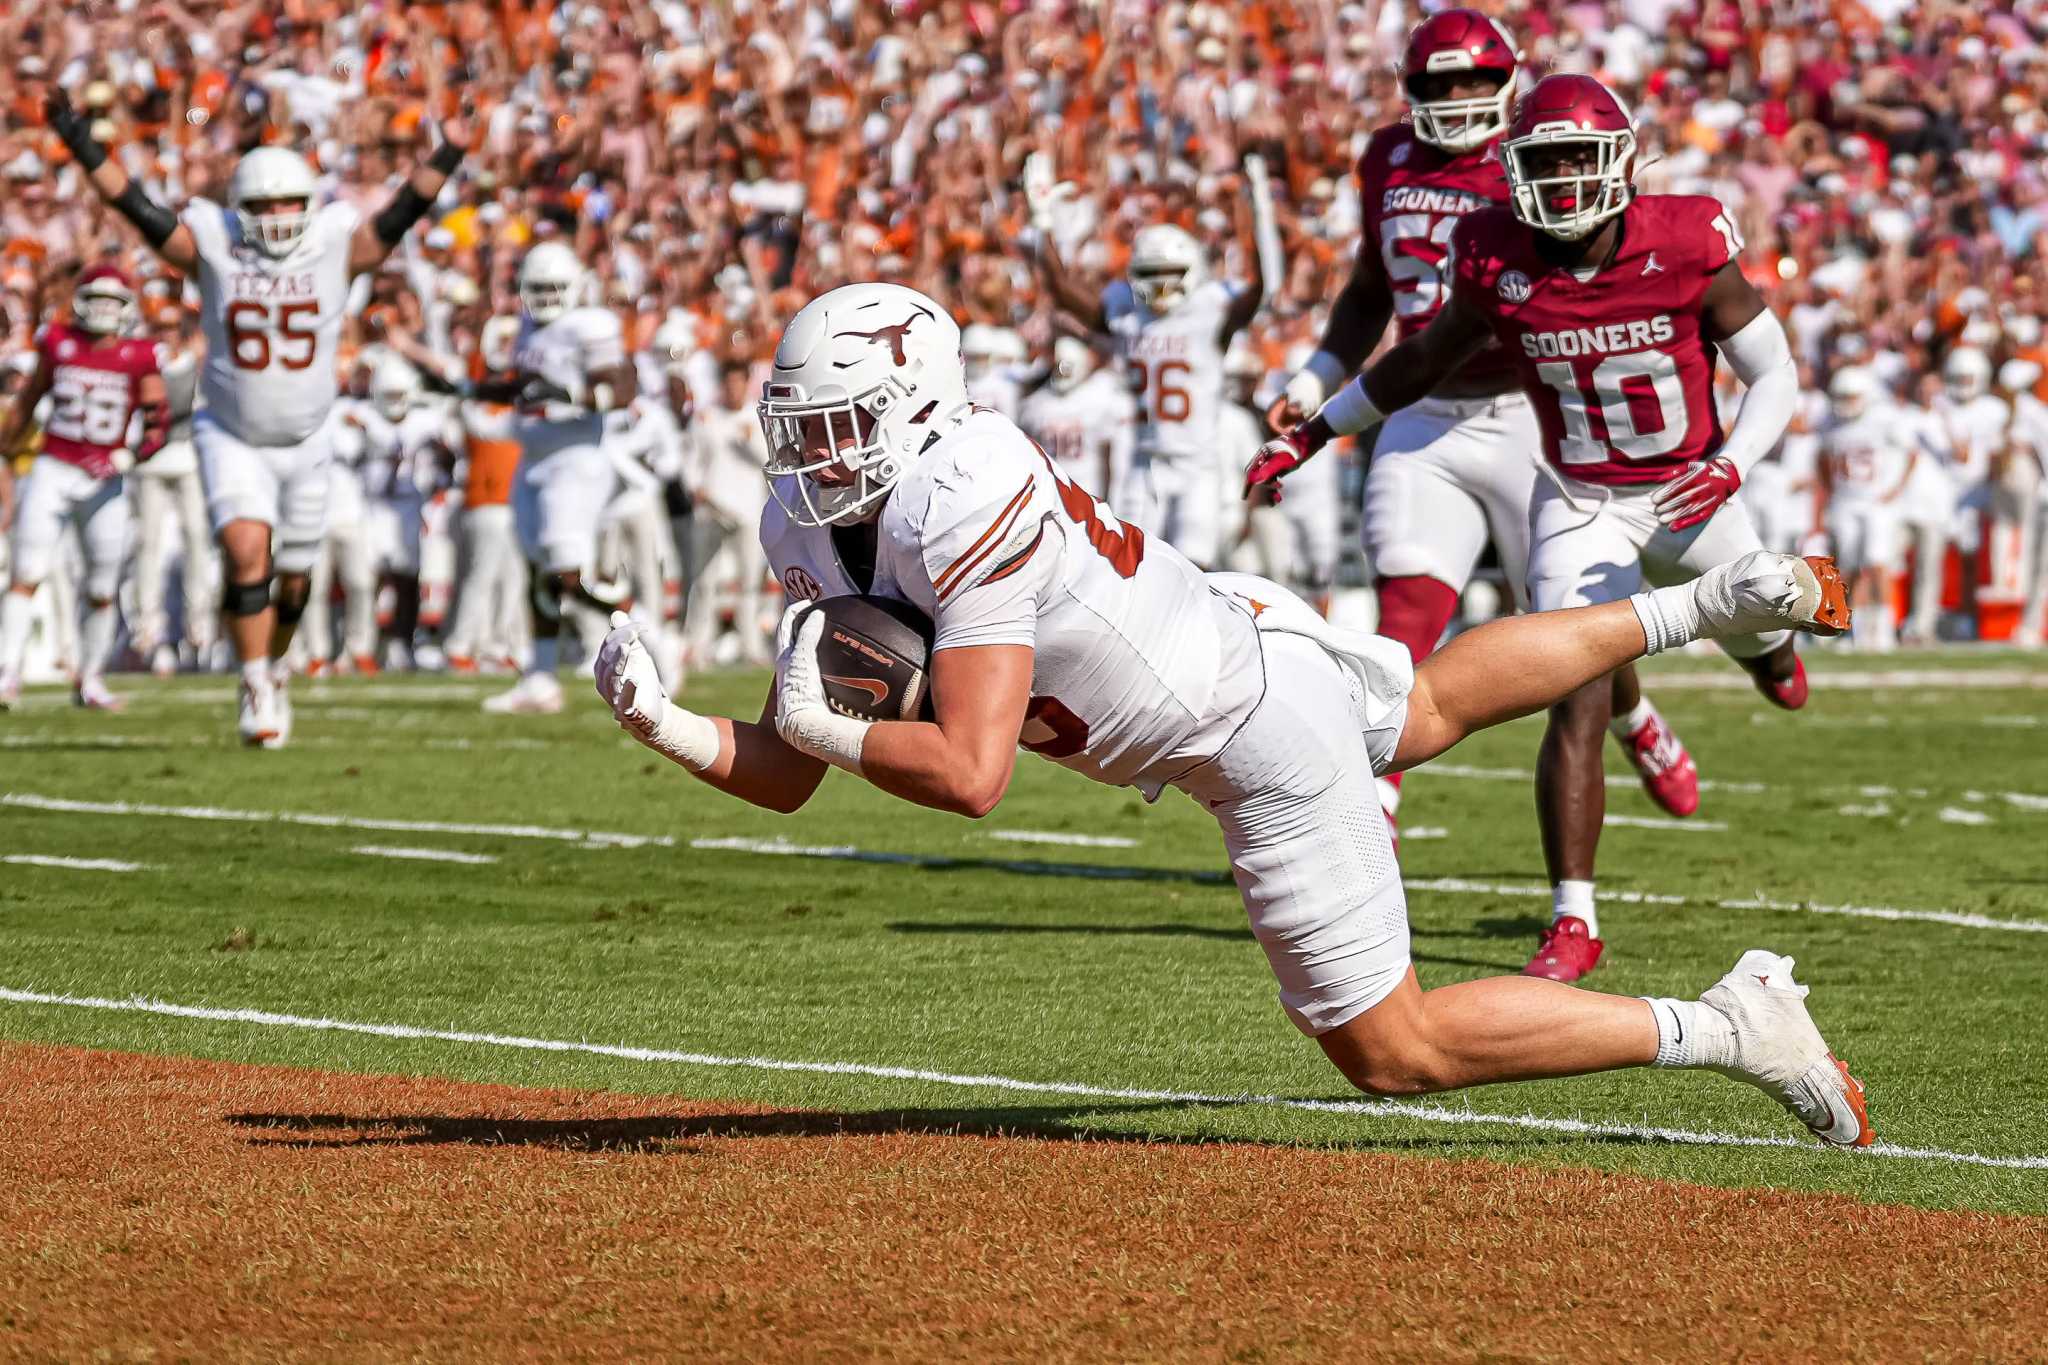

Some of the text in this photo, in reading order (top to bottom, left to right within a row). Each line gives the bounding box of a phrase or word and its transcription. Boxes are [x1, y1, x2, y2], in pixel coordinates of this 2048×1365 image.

[232, 272, 314, 296] TEXAS
[226, 300, 320, 371] 65
[1520, 314, 1675, 359] SOONERS
[1535, 349, 1688, 464] 10
